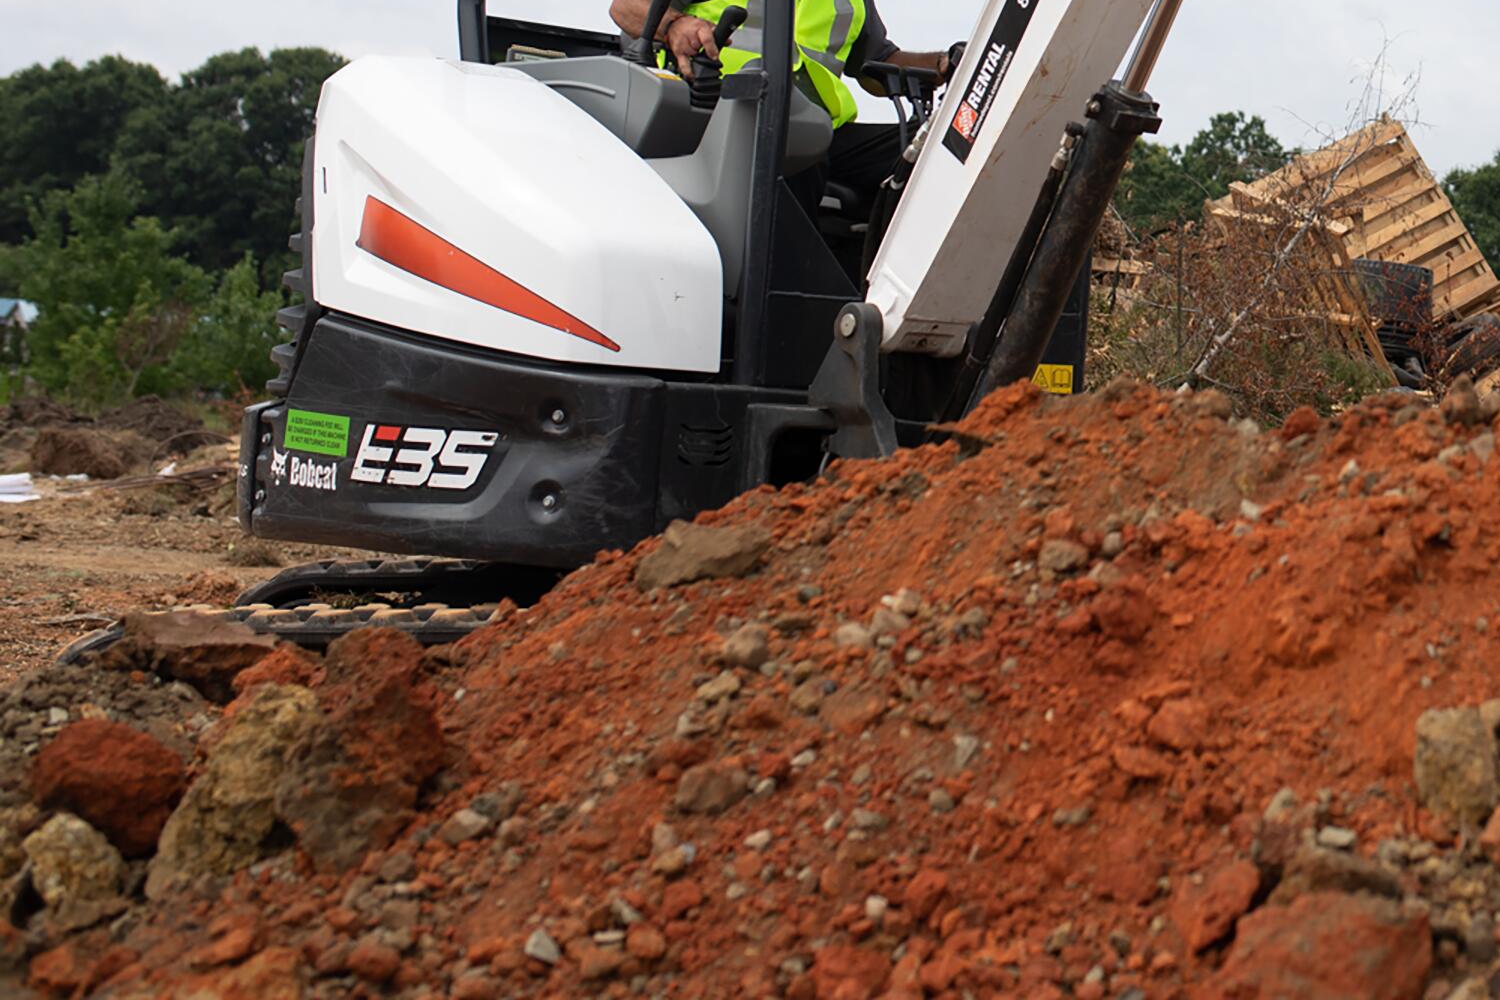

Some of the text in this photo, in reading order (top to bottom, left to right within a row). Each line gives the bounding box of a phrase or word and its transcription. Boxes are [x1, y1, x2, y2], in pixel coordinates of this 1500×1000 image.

[967, 43, 1006, 109] RENTAL
[290, 456, 337, 491] Bobcat
[351, 424, 499, 489] E35
